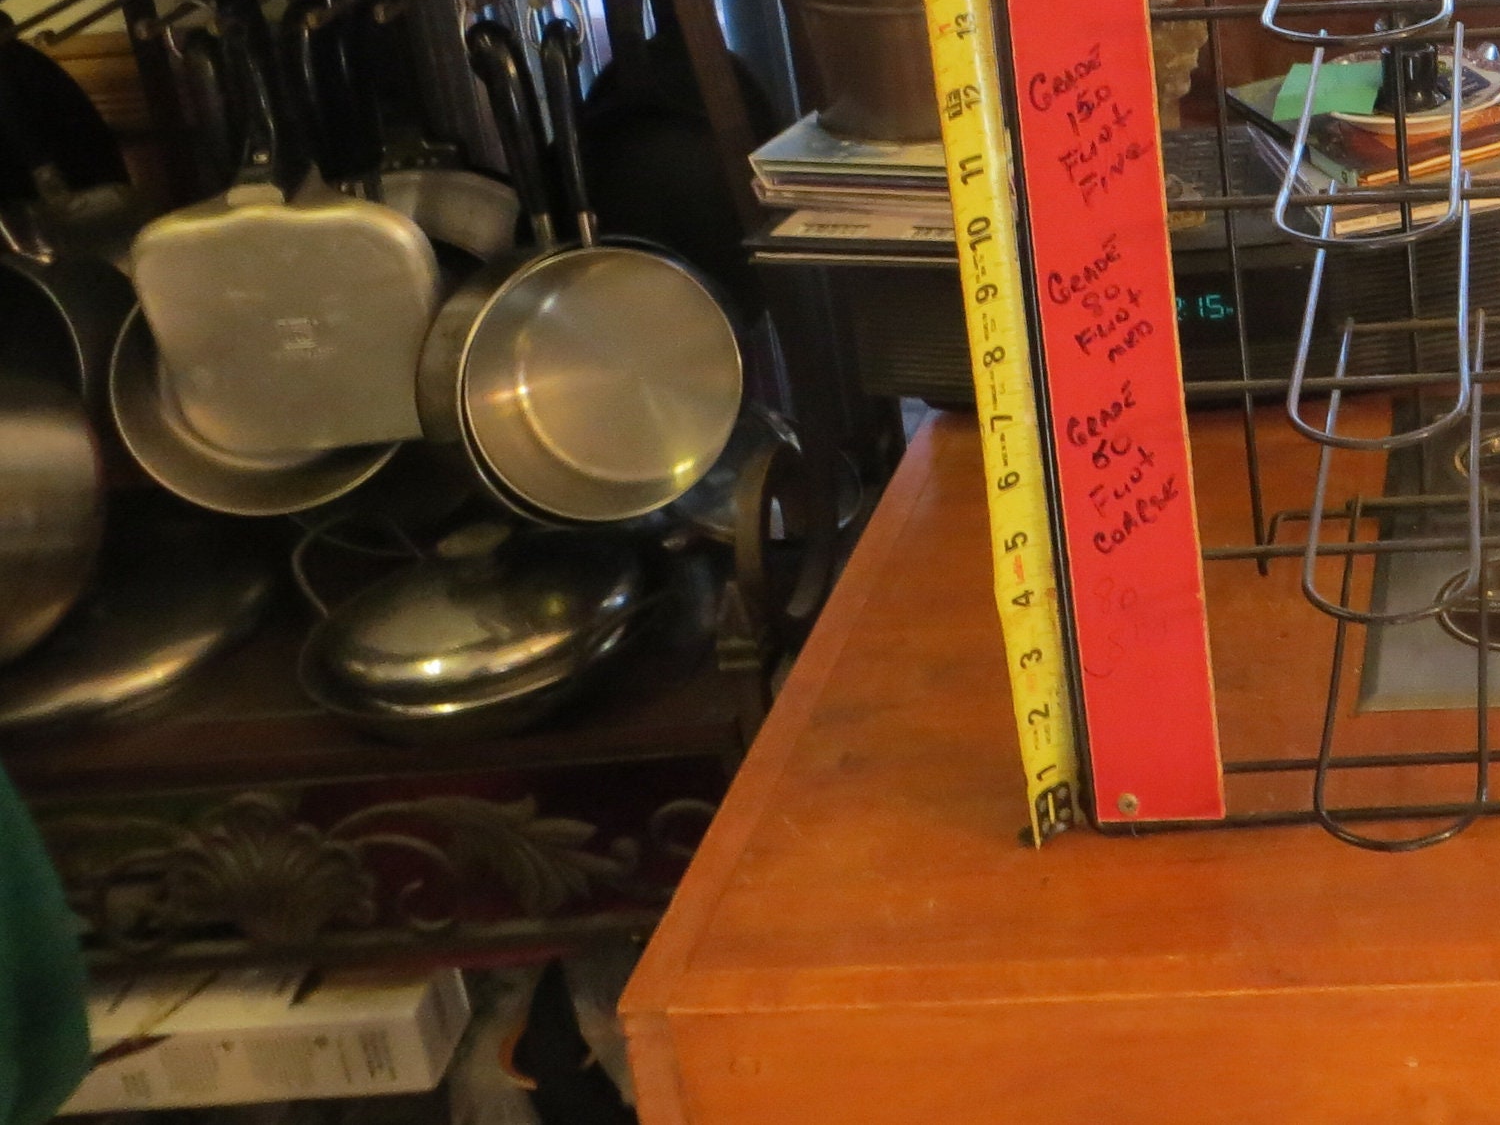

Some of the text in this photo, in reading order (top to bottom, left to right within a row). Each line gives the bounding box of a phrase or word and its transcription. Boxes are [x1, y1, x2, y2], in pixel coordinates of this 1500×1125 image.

[954, 12, 976, 40] 13
[958, 153, 985, 186] 11
[966, 215, 993, 252] 10
[975, 283, 998, 304] 9
[982, 346, 1006, 368] 8
[990, 414, 1013, 433] 7
[997, 471, 1020, 491] 6
[1004, 531, 1028, 554] 5
[1011, 589, 1034, 608] 4
[1019, 648, 1043, 670] 3
[1028, 703, 1050, 725] 2
[1036, 764, 1057, 782] 1
